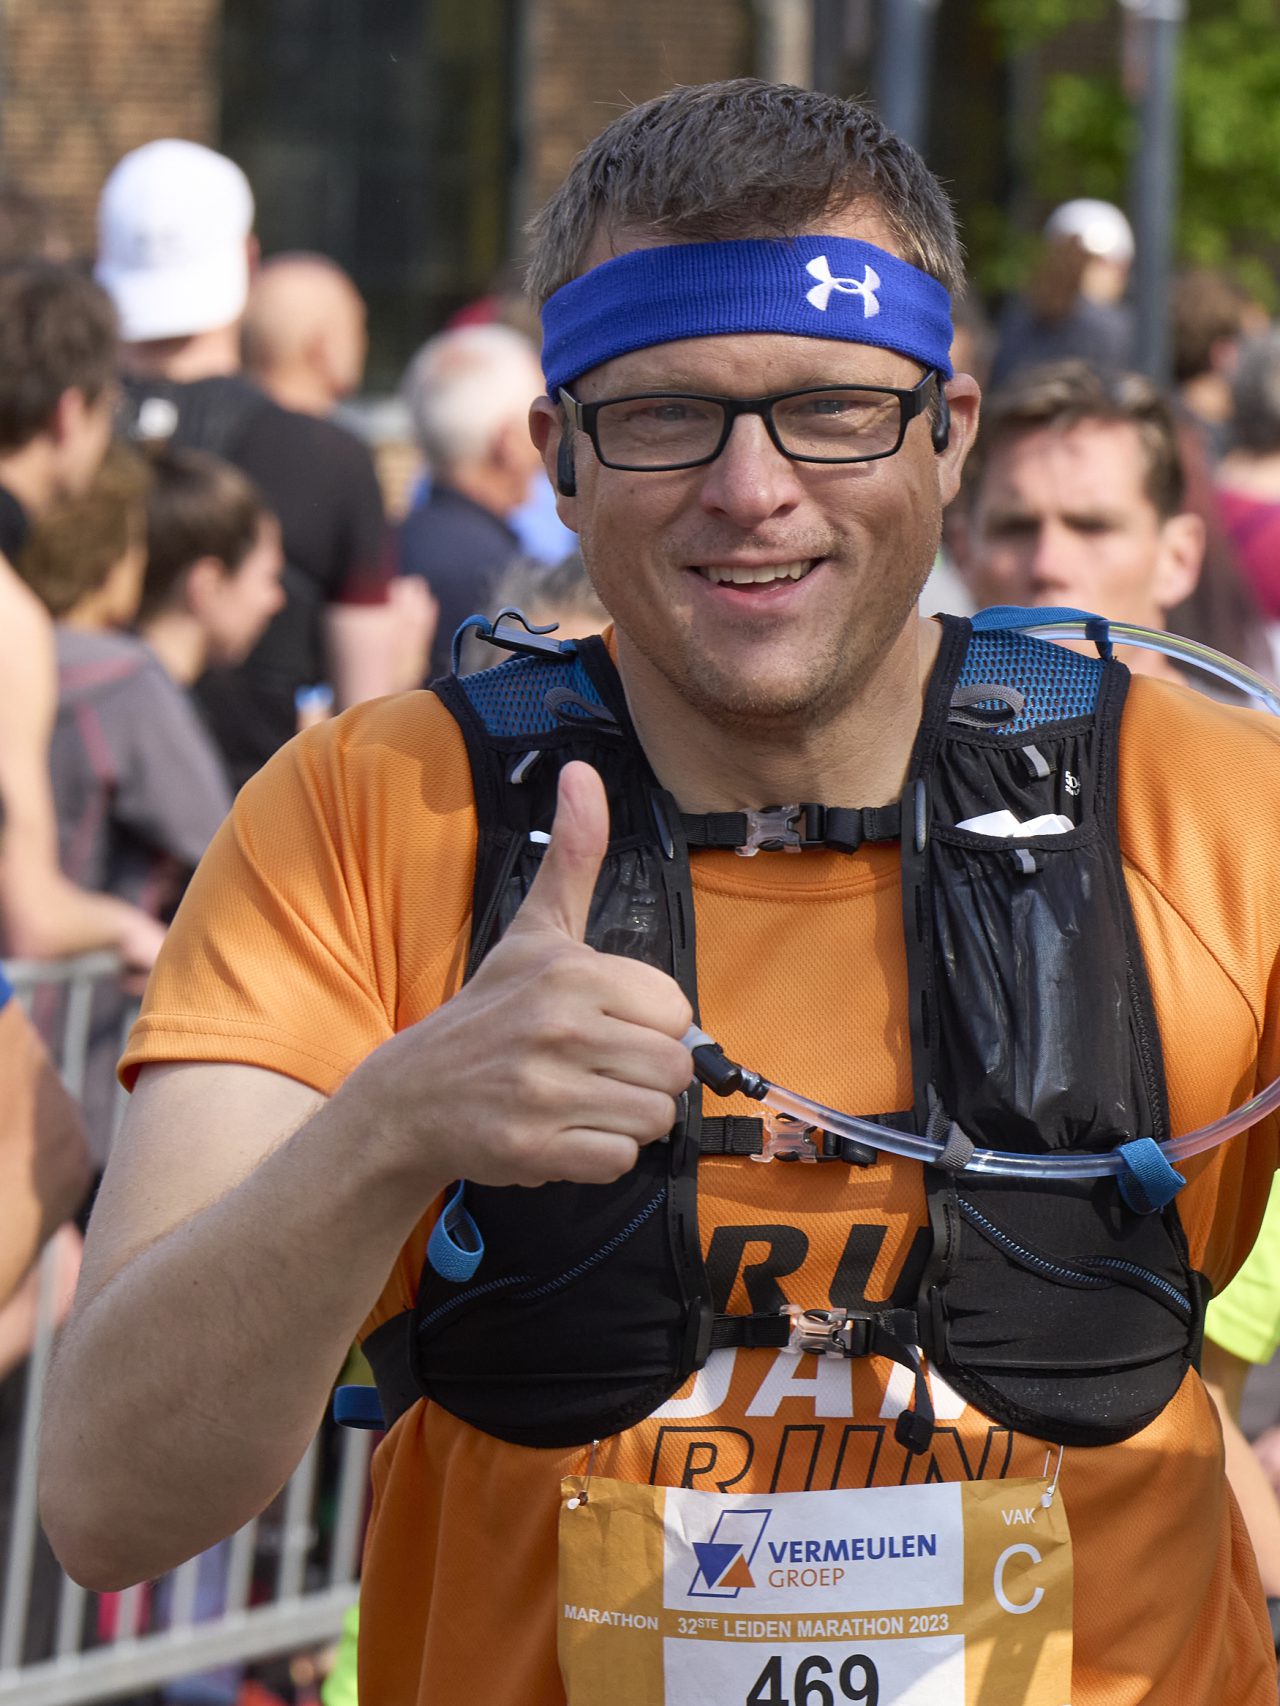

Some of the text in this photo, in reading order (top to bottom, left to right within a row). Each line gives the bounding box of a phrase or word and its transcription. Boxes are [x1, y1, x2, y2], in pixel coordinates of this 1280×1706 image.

[1001, 1508, 1036, 1526] VAK
[768, 1533, 937, 1564] VERMEULEN
[768, 1567, 845, 1588] GROEP
[993, 1543, 1045, 1614] C
[564, 1603, 659, 1630] MARATHON
[723, 1619, 791, 1638] LEIDEN
[797, 1616, 904, 1638] MARATHON
[908, 1613, 949, 1634] 2023
[746, 1653, 880, 1706] 469
